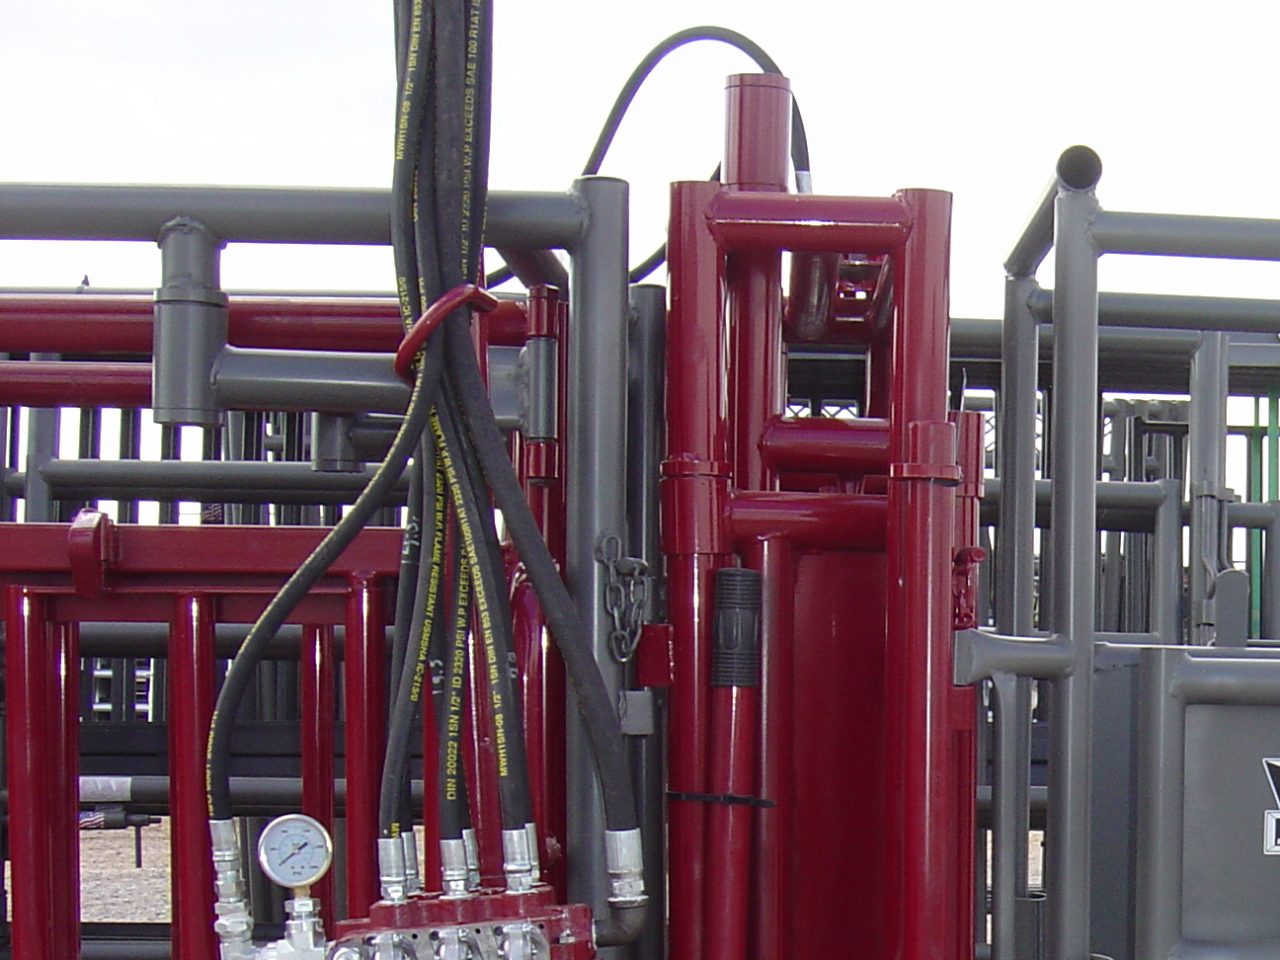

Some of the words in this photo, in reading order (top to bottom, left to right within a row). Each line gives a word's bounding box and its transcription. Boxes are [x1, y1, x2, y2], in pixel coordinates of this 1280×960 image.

[467, 41, 478, 58] 100
[466, 63, 477, 86] SAE
[464, 88, 476, 142] EXCEEDS
[425, 565, 441, 617] RESISTANT
[458, 555, 471, 607] EXCEEDS
[470, 565, 488, 610] EXCEEDS
[456, 608, 467, 628] W.P
[455, 629, 467, 648] PSI
[483, 628, 495, 644] EN
[452, 649, 465, 675] 2320
[485, 645, 498, 664] DIN
[452, 676, 463, 689] ID
[448, 714, 460, 737] 1SN
[446, 741, 458, 776] 20022
[446, 778, 457, 800] DIN
